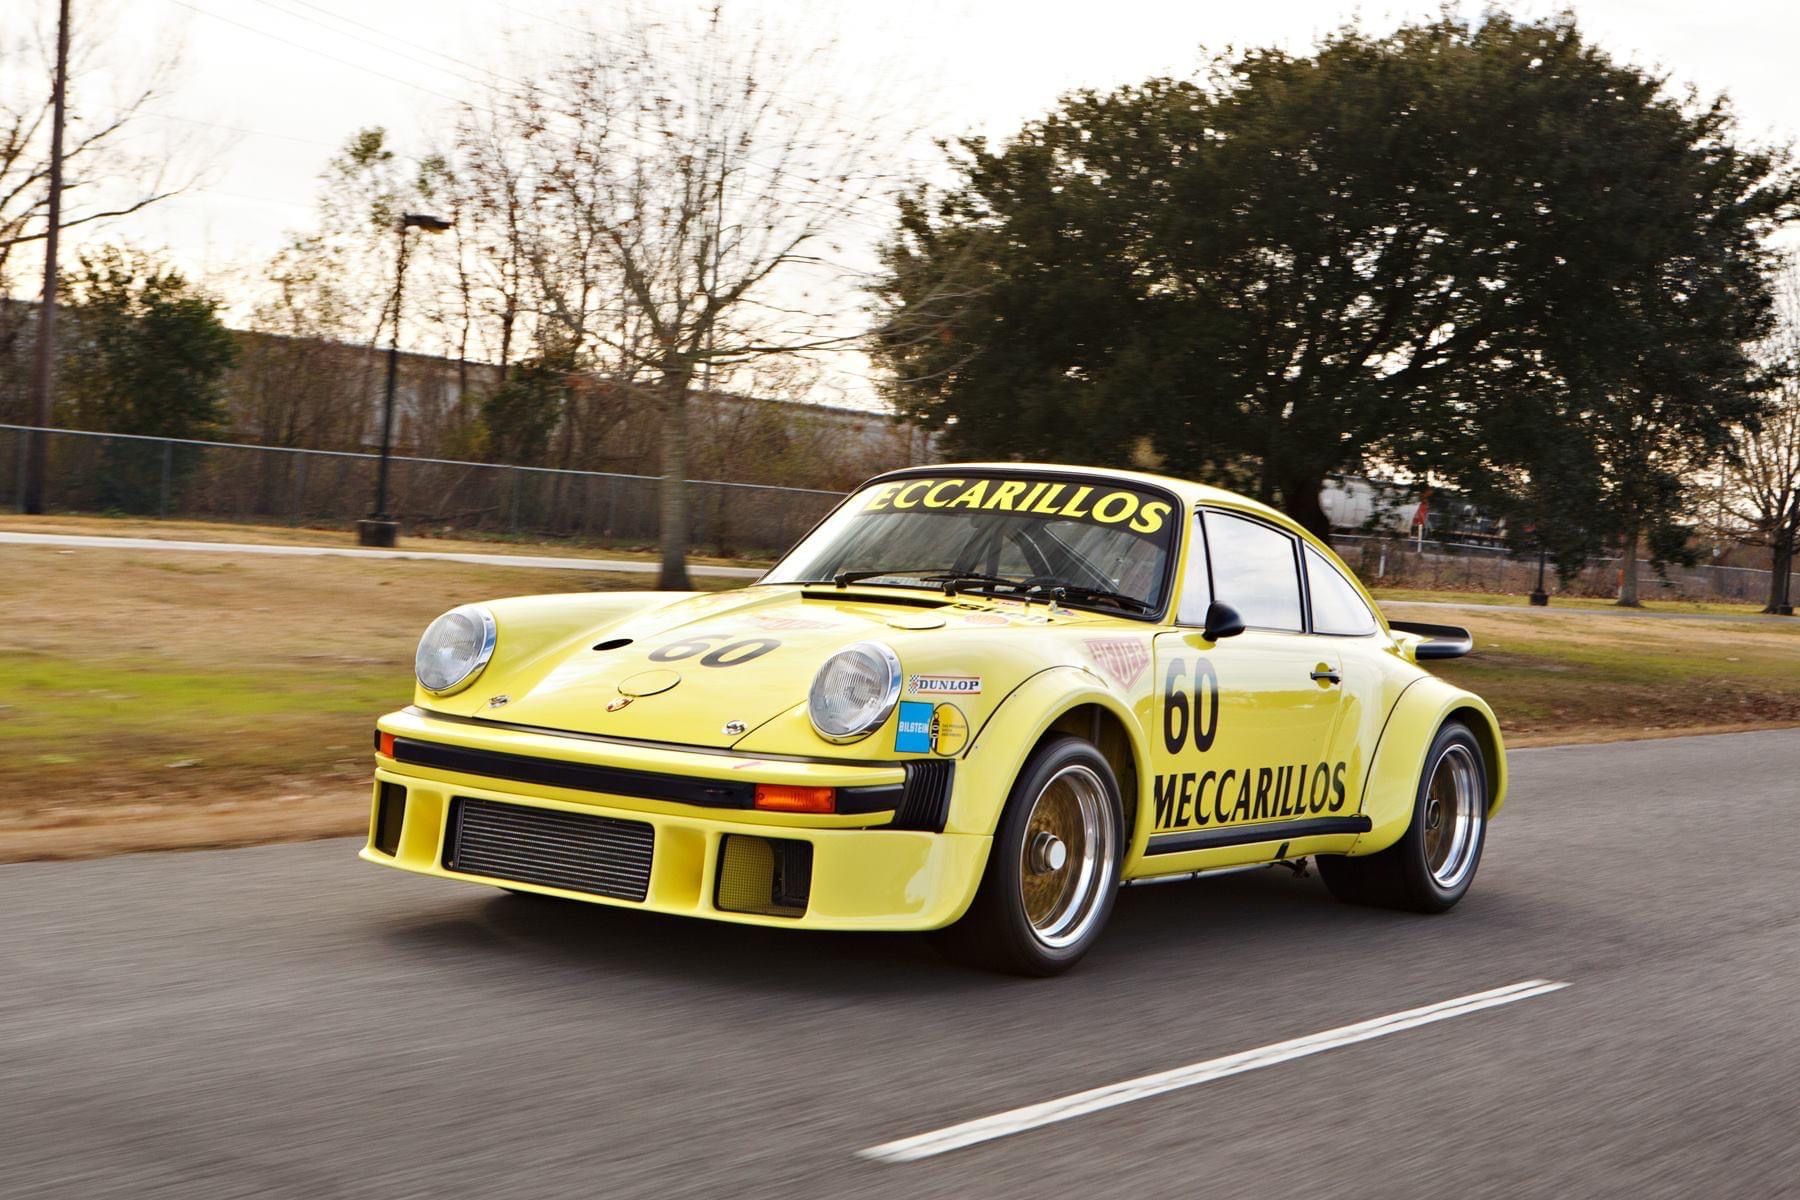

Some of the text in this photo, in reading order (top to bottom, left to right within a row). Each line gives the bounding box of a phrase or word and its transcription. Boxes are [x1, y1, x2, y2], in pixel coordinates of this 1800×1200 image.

[648, 633, 782, 668] 60
[1086, 641, 1147, 683] HEUER
[918, 679, 979, 691] DUNLOP
[1163, 656, 1219, 755] 60
[898, 721, 929, 734] BILSTEIN
[1153, 761, 1346, 829] MECCARILLOS
